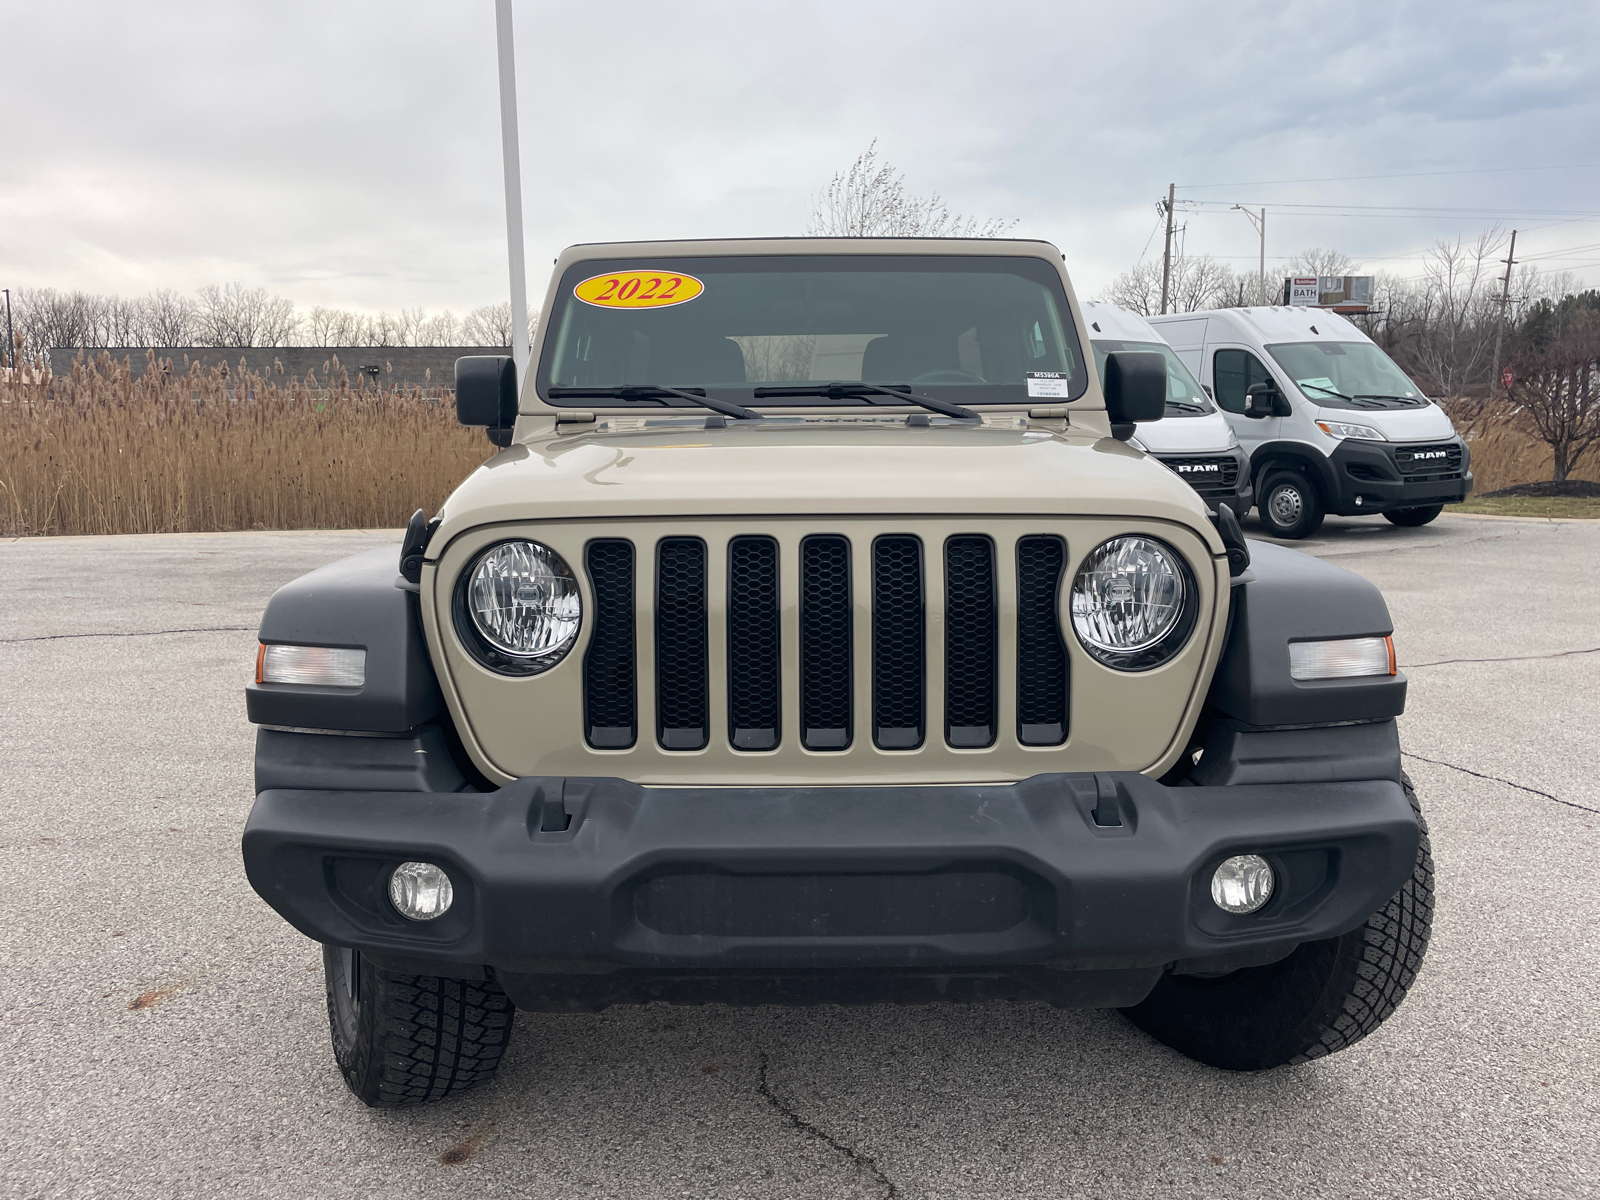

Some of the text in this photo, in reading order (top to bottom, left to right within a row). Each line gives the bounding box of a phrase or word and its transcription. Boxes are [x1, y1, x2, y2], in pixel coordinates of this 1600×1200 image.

[594, 277, 682, 301] 2022
[1294, 289, 1316, 297] BATH
[1414, 451, 1446, 460] RAM
[1178, 465, 1218, 473] RAM
